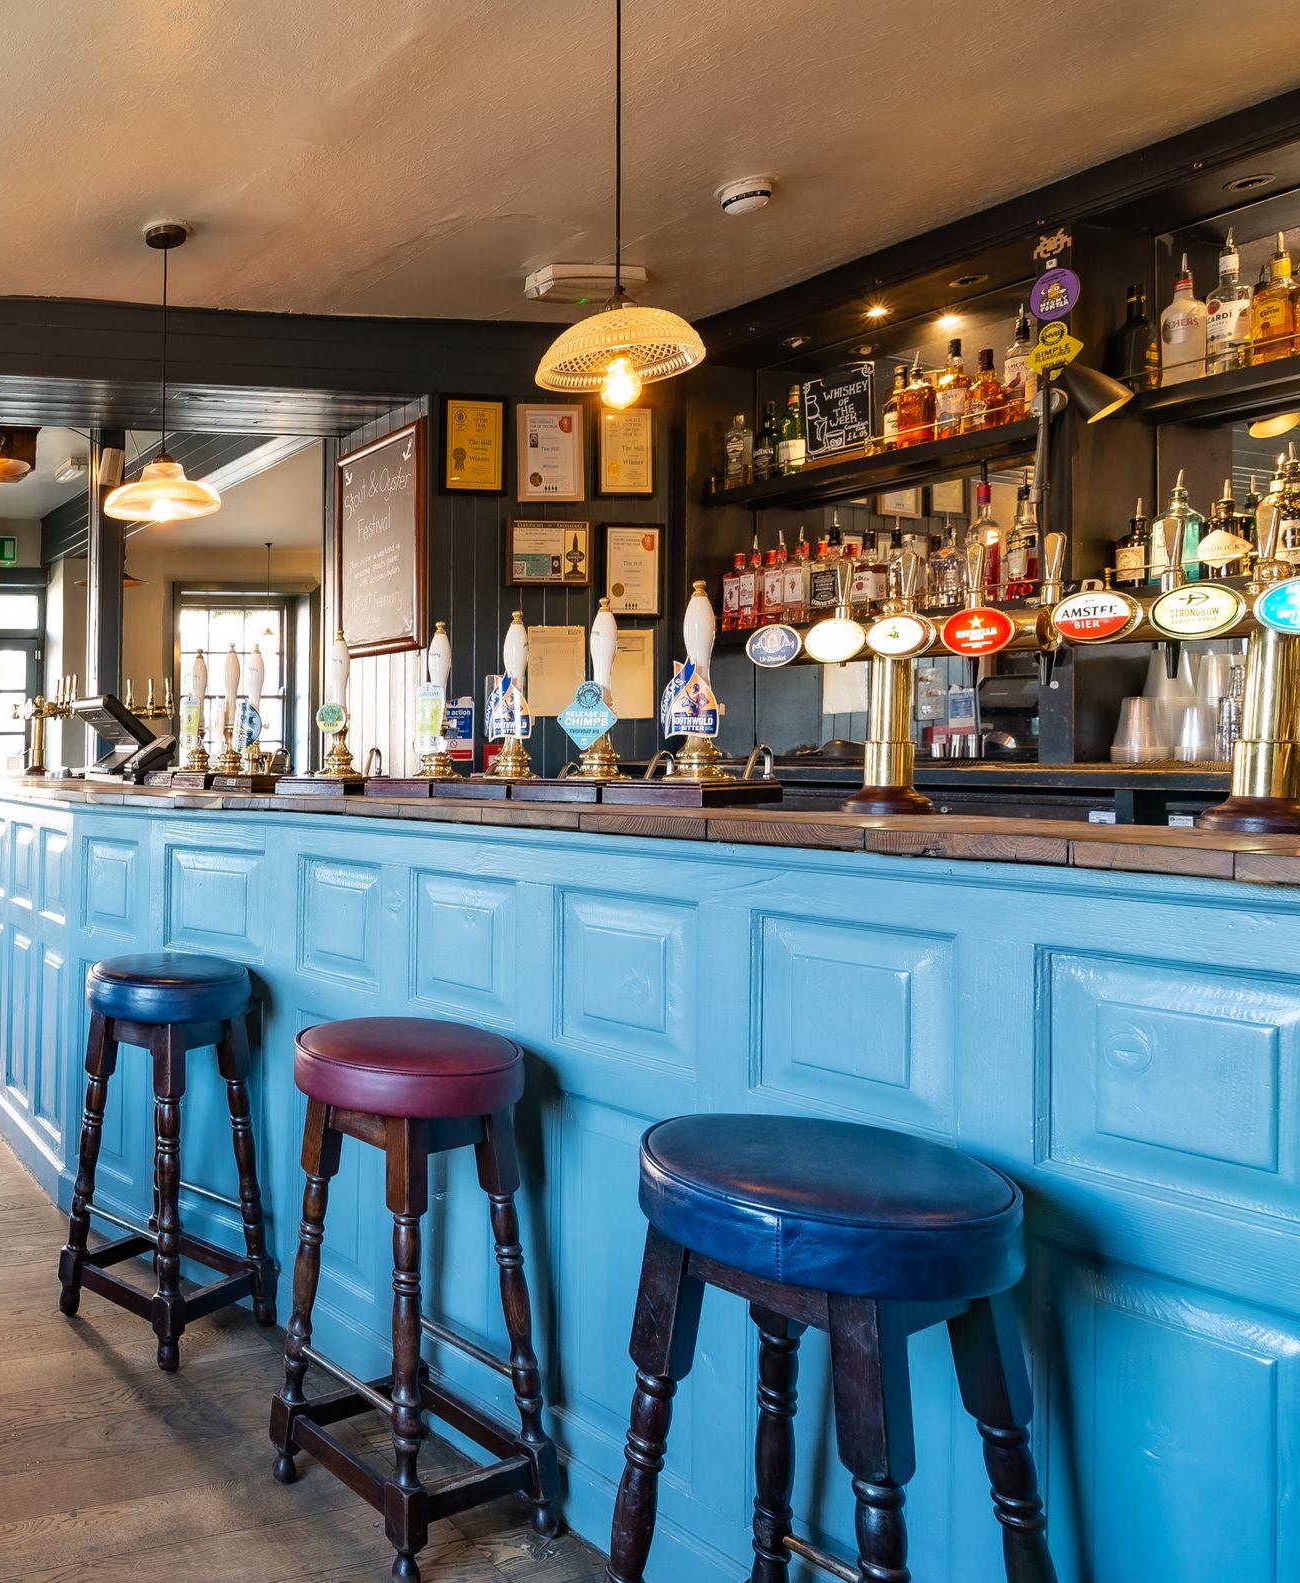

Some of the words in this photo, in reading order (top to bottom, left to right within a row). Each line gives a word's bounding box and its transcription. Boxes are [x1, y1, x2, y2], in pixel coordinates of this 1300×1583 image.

[1035, 343, 1070, 359] SIMPLE
[823, 379, 868, 400] WHISKEY
[838, 396, 849, 407] OF
[832, 403, 855, 417] THE
[480, 438, 492, 447] Mill
[344, 479, 366, 521] Stout
[369, 470, 379, 498] &
[380, 467, 412, 502] Oyster
[357, 505, 391, 543] Festival
[1074, 620, 1100, 630] BIER
[564, 717, 609, 727] CHIMPS
